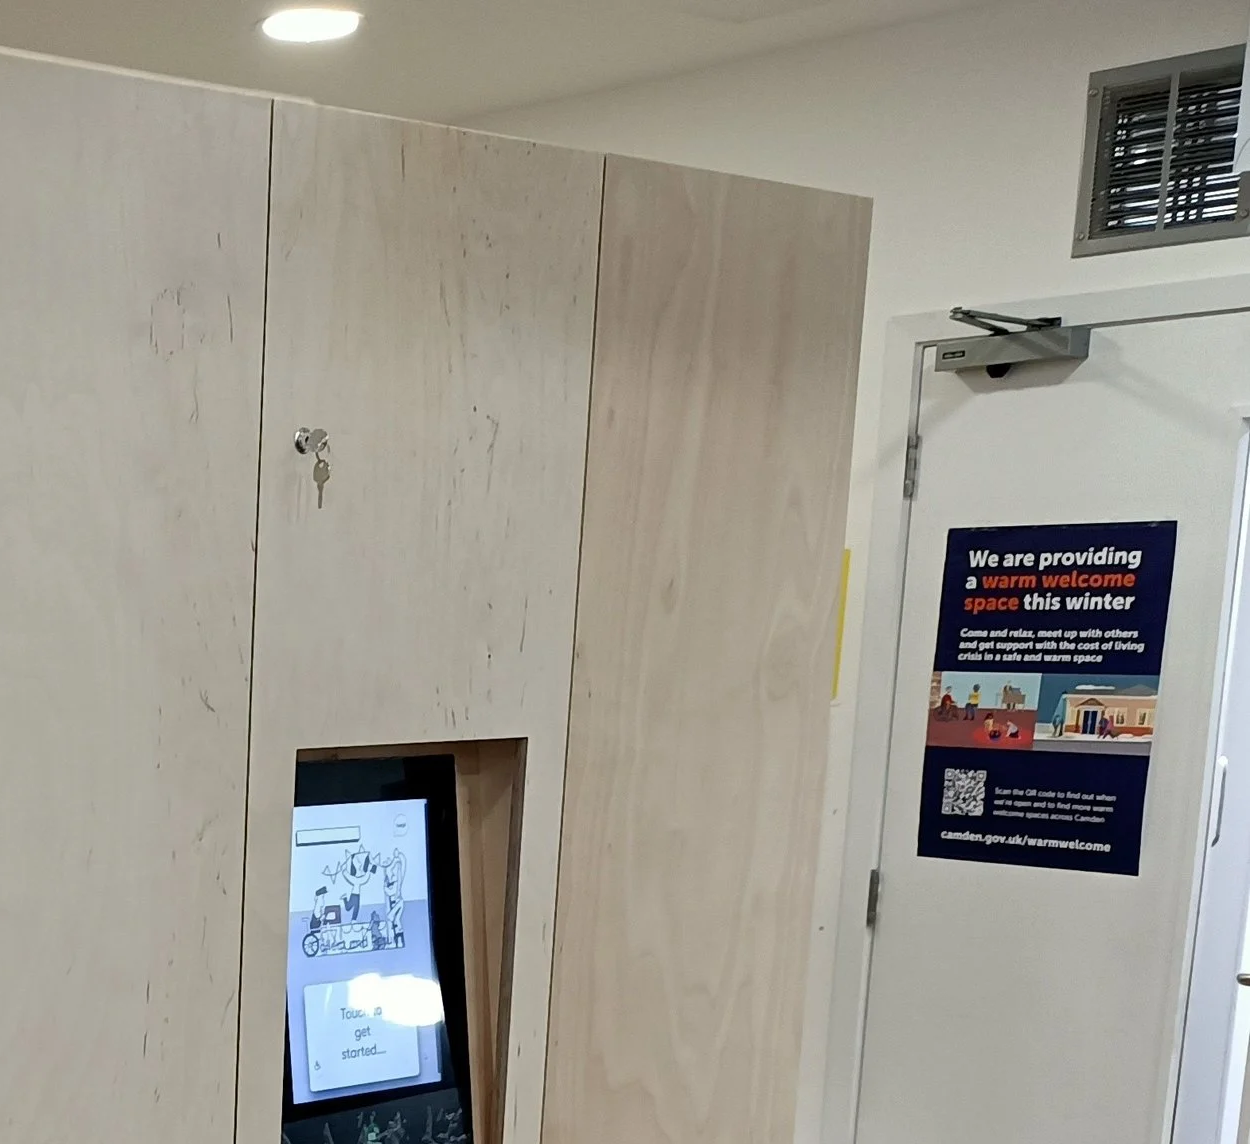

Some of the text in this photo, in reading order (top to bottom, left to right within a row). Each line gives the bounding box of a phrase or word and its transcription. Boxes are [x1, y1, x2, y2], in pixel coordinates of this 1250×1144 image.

[968, 546, 1142, 570] We are providing
[965, 570, 1136, 589] a warm welcome
[964, 592, 1136, 615] space this winter
[960, 628, 988, 638] Come
[989, 628, 1008, 638] and
[1037, 629, 1062, 638] meet
[1063, 630, 1078, 640] up
[1079, 628, 1103, 638] with
[1104, 629, 1139, 638] others
[959, 640, 1145, 653] and get support with the cost of living
[958, 652, 982, 661] crisis
[983, 652, 994, 661] in
[1002, 652, 1022, 662] safe
[1023, 652, 1042, 662] and
[1043, 654, 1071, 662] warm
[1073, 654, 1103, 664] space
[940, 830, 1112, 852] camden.gov.uk/warmwelcome
[354, 1025, 371, 1042] get
